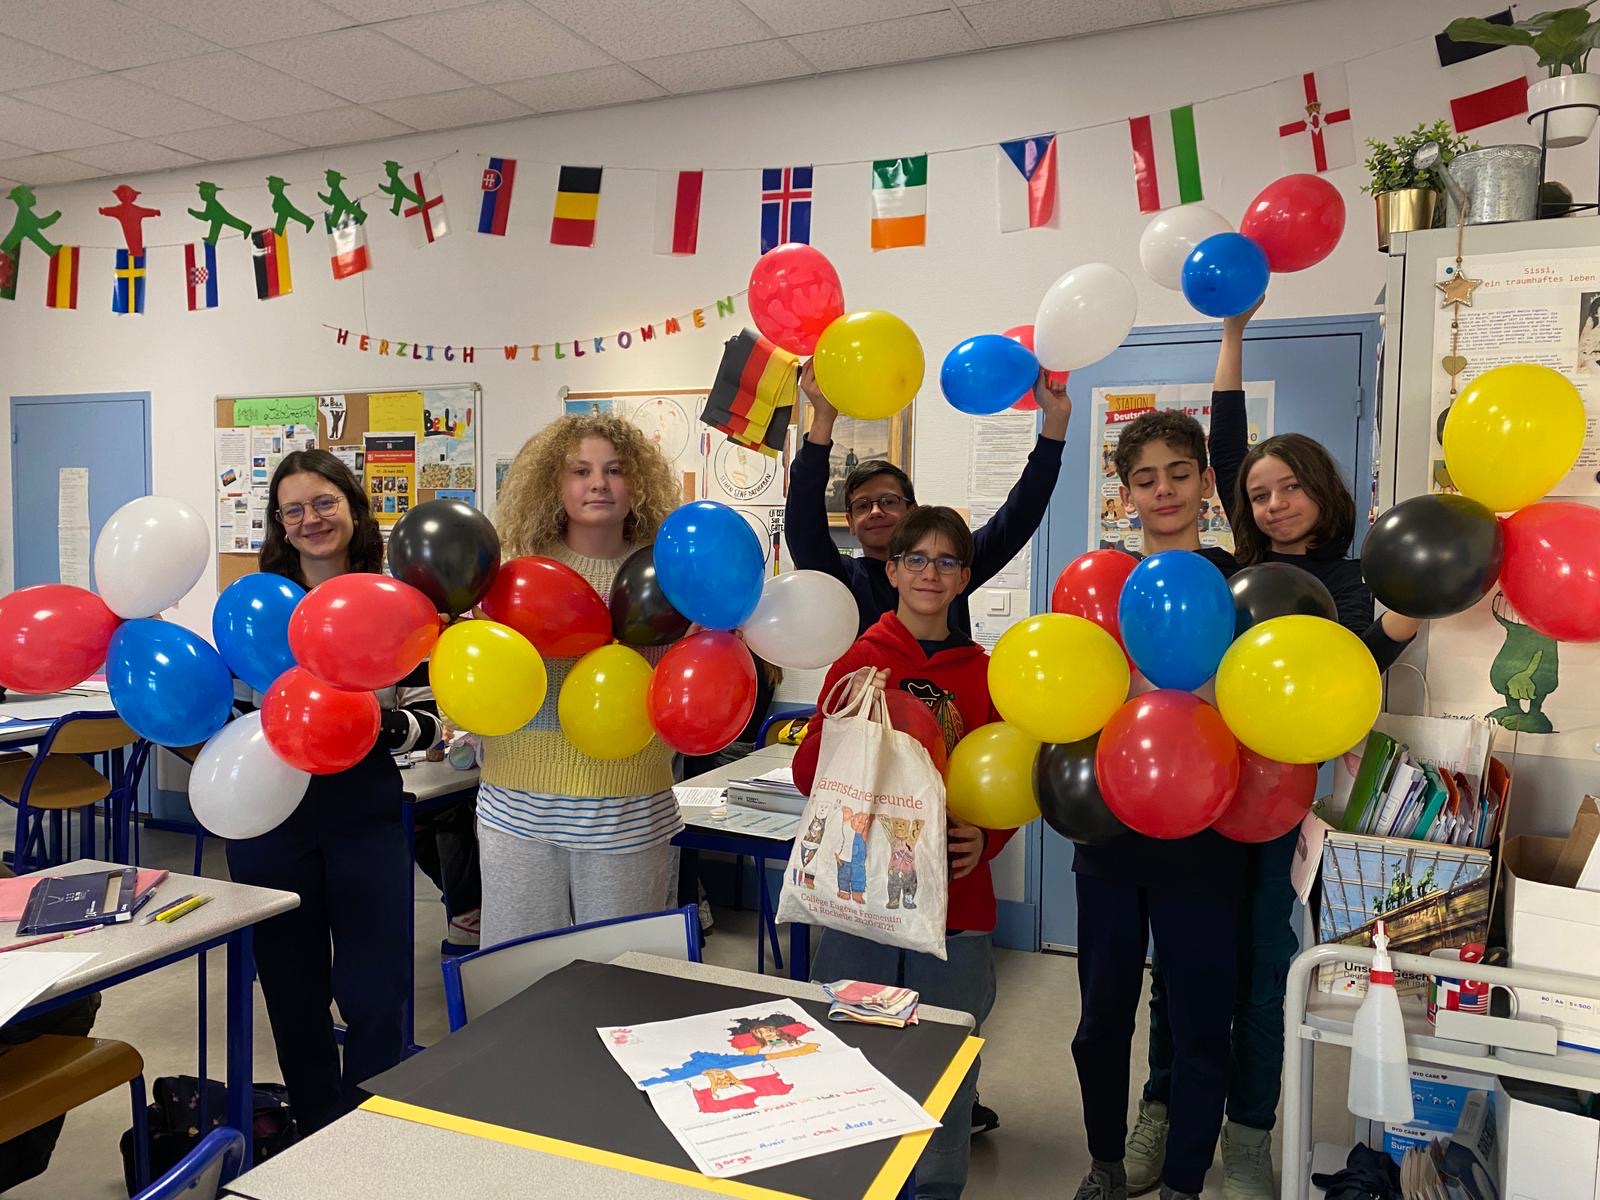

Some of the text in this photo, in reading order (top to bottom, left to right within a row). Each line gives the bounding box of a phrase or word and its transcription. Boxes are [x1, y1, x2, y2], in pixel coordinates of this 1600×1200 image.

[1506, 275, 1564, 286] traumhaftes
[1569, 274, 1596, 282] leben
[337, 295, 734, 363] HERZLICH WILLKOMMEN
[1116, 397, 1149, 410] STATION
[801, 892, 902, 924] Collège Eugène Fromentin
[808, 903, 818, 912] La
[819, 907, 853, 921] Rochelle
[813, 1126, 840, 1137] chat
[844, 1120, 873, 1130] dans
[715, 1155, 752, 1169] gorge
